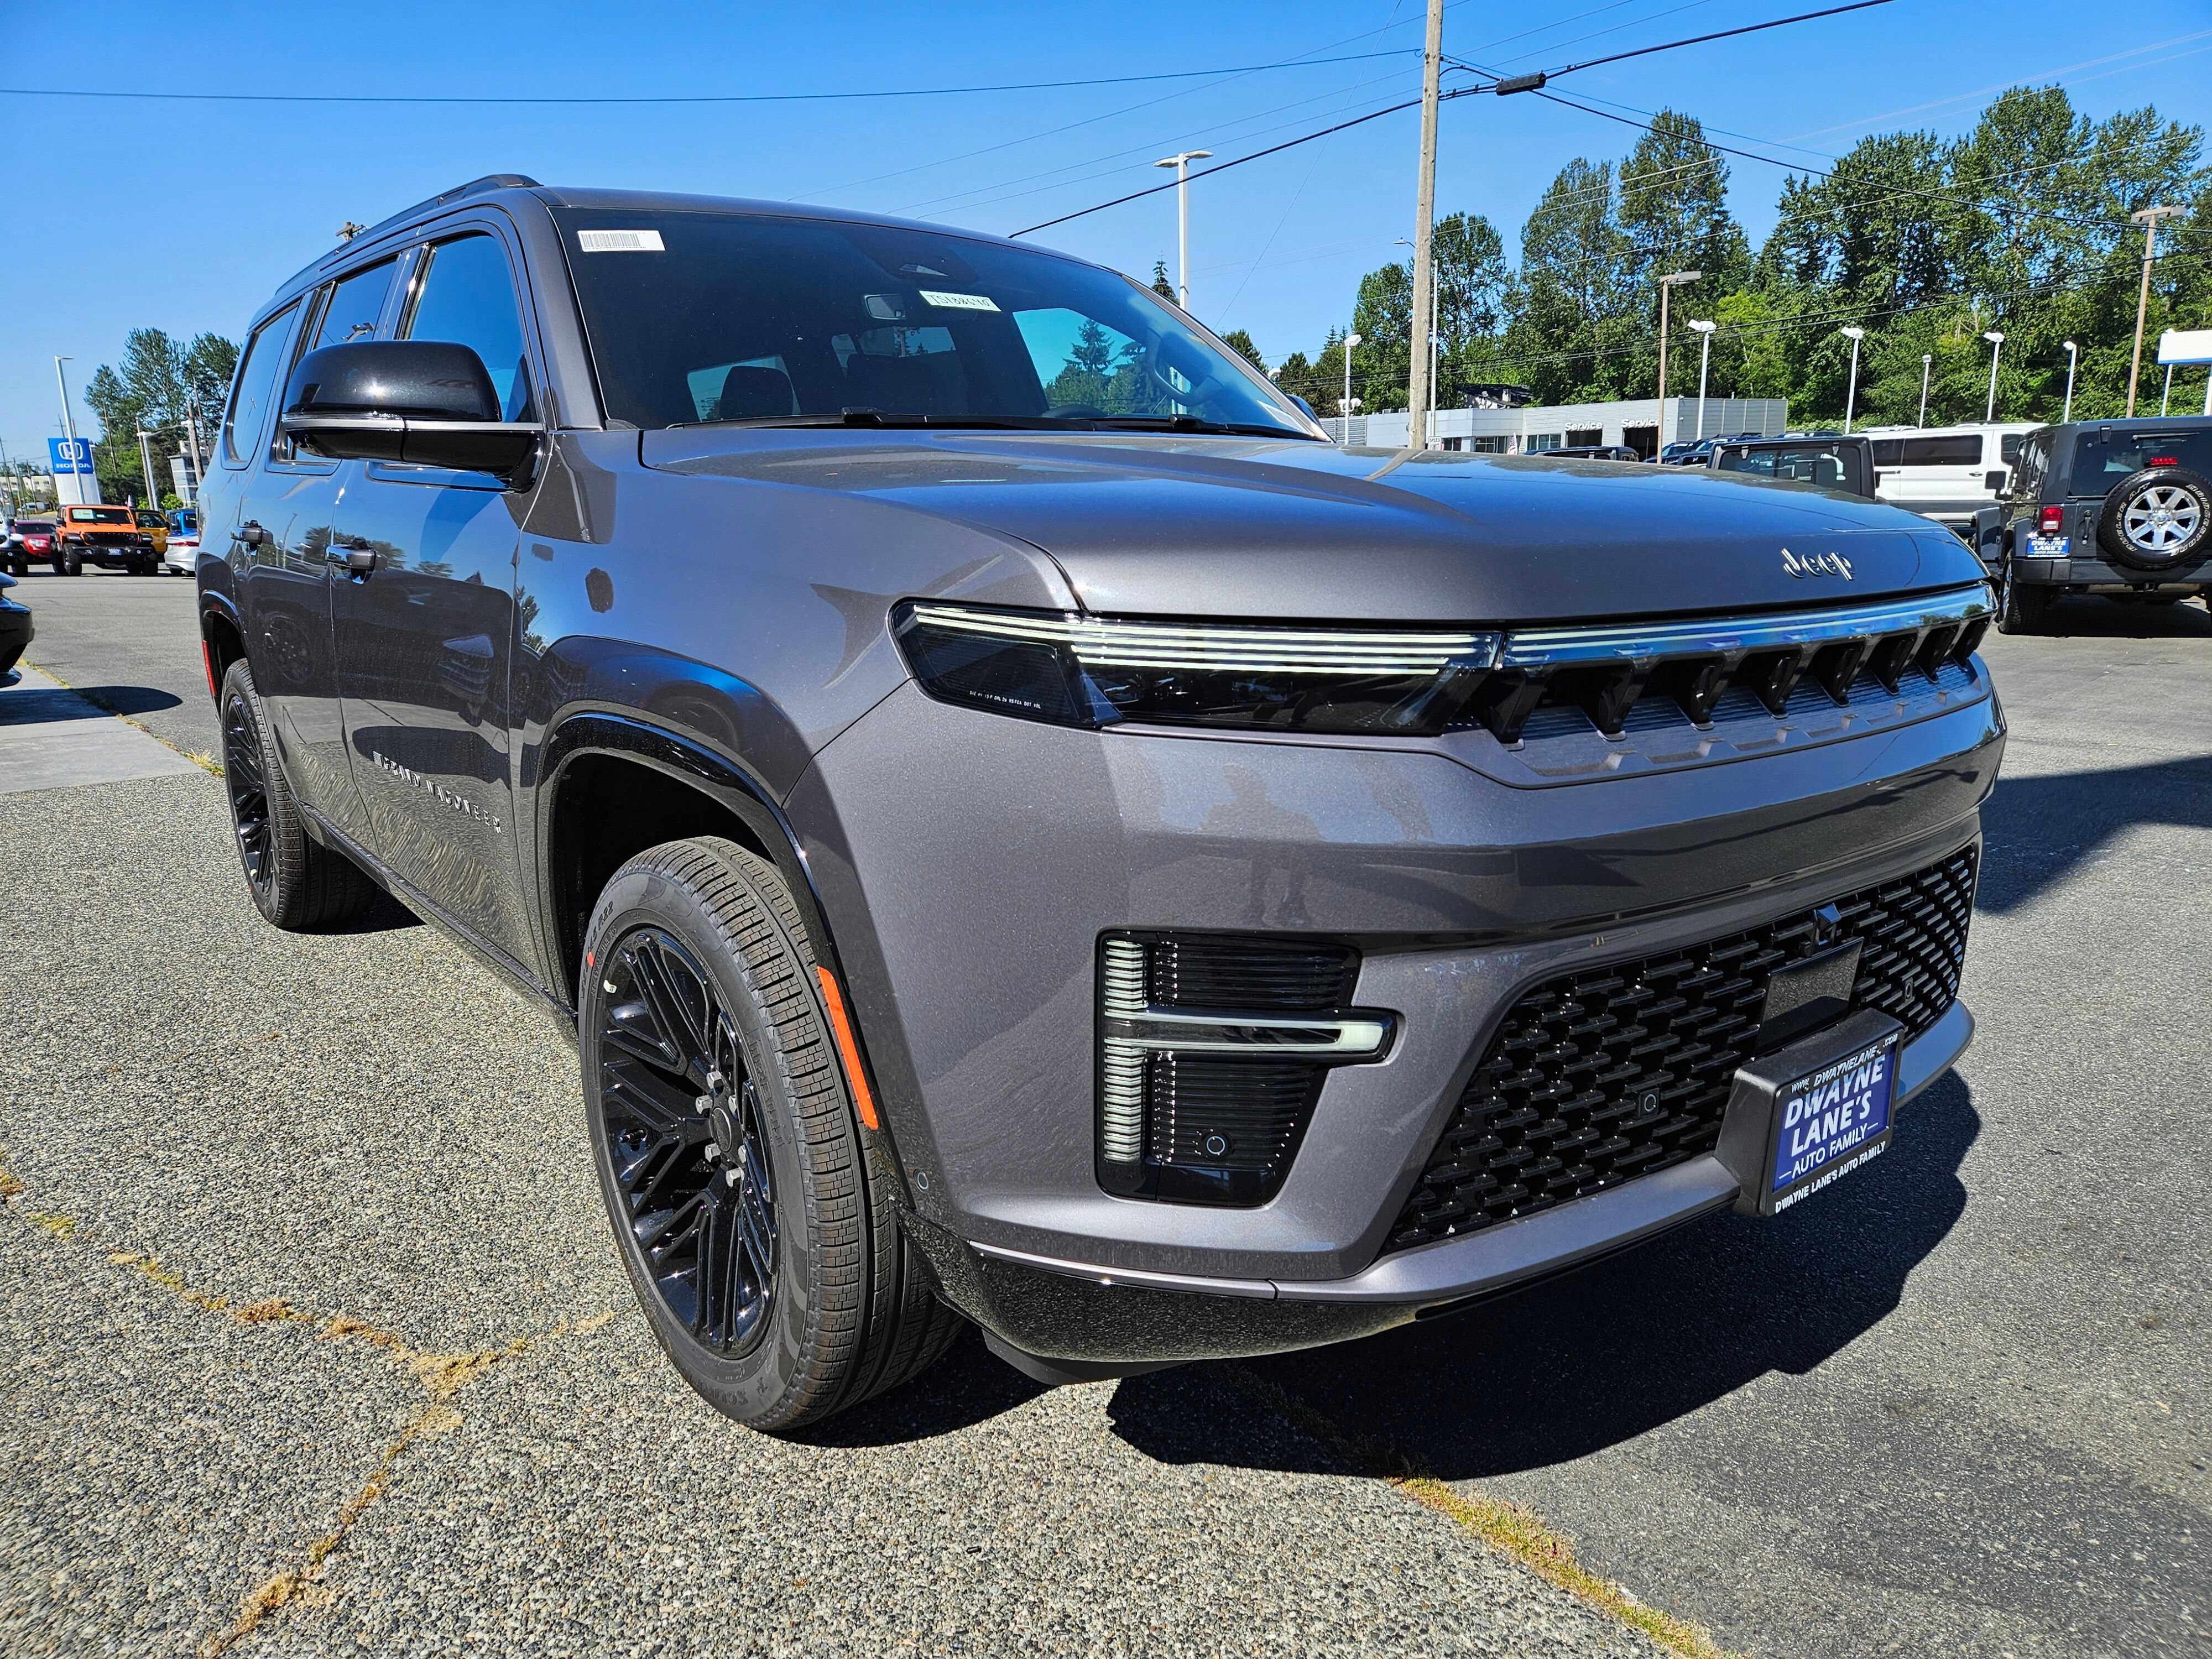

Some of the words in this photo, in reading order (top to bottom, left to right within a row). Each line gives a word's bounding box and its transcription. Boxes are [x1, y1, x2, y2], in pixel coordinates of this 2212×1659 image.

[1564, 421, 1604, 431] Service
[1621, 418, 1660, 429] Service
[1781, 548, 1856, 581] Jeep
[384, 757, 421, 787] GRAND
[426, 780, 502, 833] WAGONEER
[1785, 1054, 1886, 1129] DWAYNE
[1813, 1045, 1878, 1087] DWAYNELANE
[1791, 1089, 1872, 1157] LANE'S
[1792, 1147, 1825, 1179] AUTO
[1829, 1123, 1868, 1157] FAMILY
[1775, 1185, 1810, 1214] DWAYNE
[1811, 1169, 1838, 1193] LANE'S
[1838, 1157, 1858, 1178] AUTO
[1859, 1141, 1886, 1166] FAMILY
